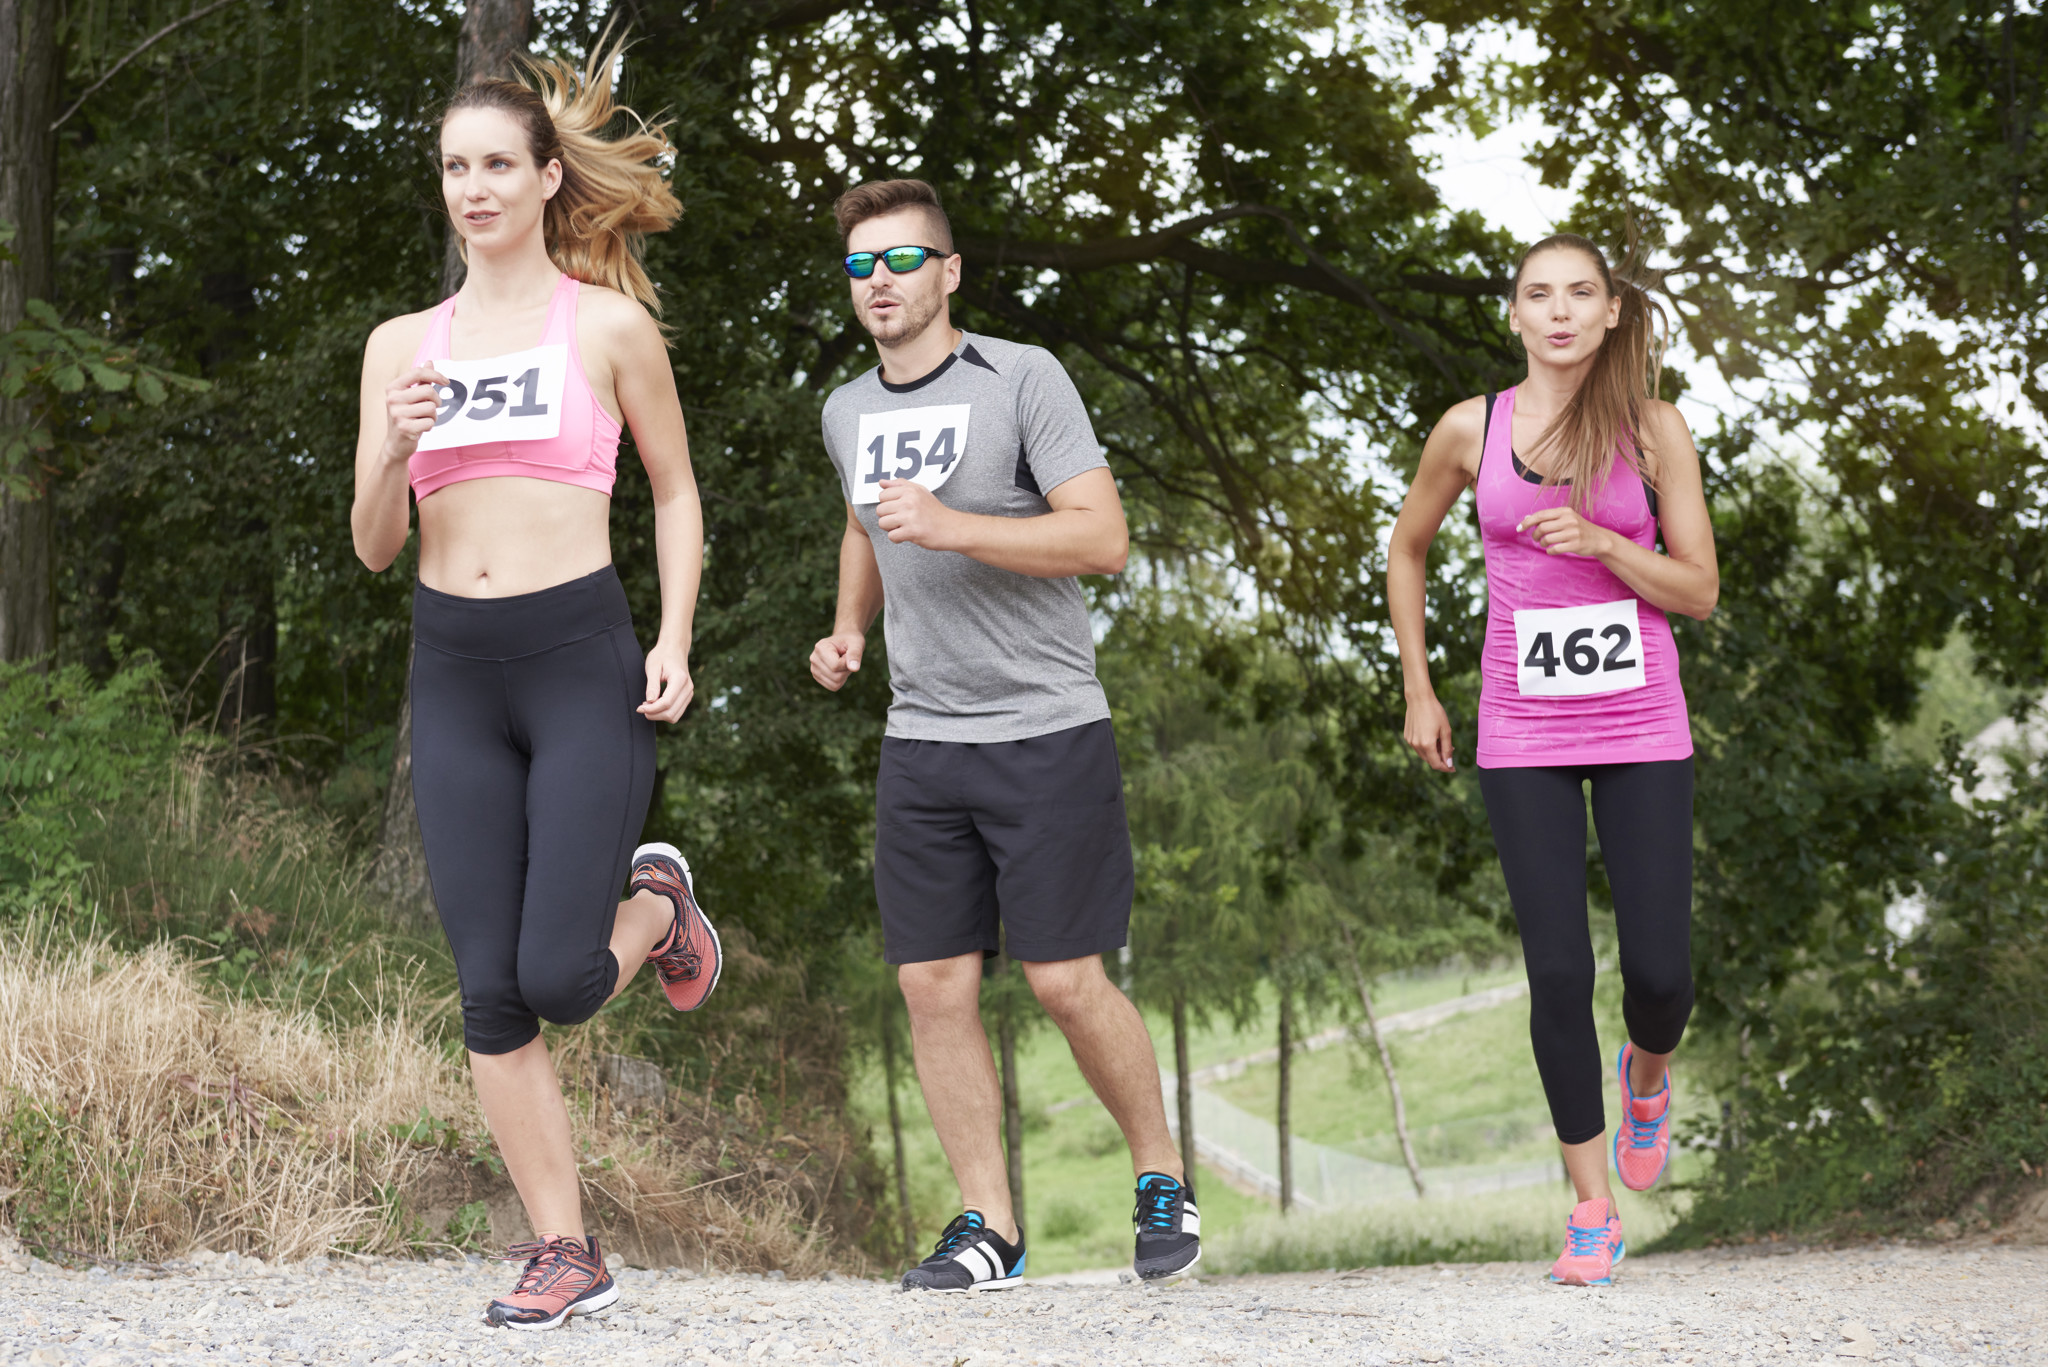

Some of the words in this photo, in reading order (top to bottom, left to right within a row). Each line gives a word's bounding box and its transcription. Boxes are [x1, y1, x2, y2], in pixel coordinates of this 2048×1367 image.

[432, 367, 548, 427] 951
[864, 427, 957, 484] 154
[1524, 623, 1636, 677] 462
